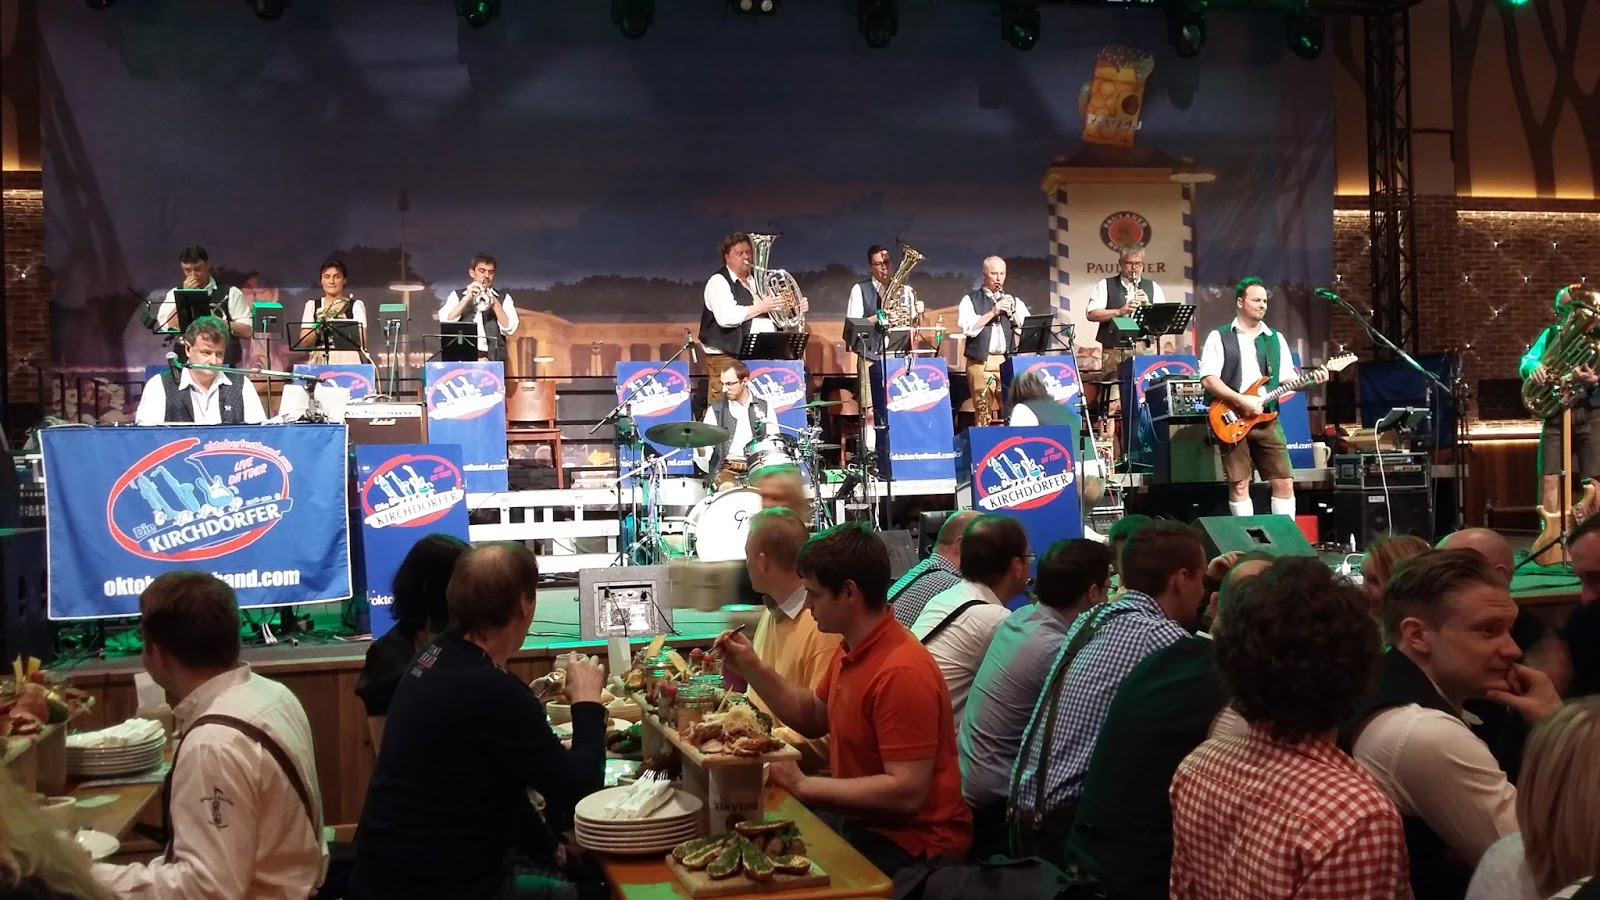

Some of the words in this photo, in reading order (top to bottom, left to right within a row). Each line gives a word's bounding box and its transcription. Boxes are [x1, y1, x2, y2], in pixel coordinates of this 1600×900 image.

[1086, 262, 1166, 274] PAULER
[228, 471, 242, 486] ON
[242, 463, 268, 481] TOUR
[233, 456, 254, 472] LIVE
[989, 474, 1069, 508] KIRCHDORFER
[375, 491, 458, 525] KIRCHDORFER
[132, 518, 157, 539] Die
[147, 503, 281, 554] KIRCHDORFER
[103, 569, 300, 597] oktobband.com
